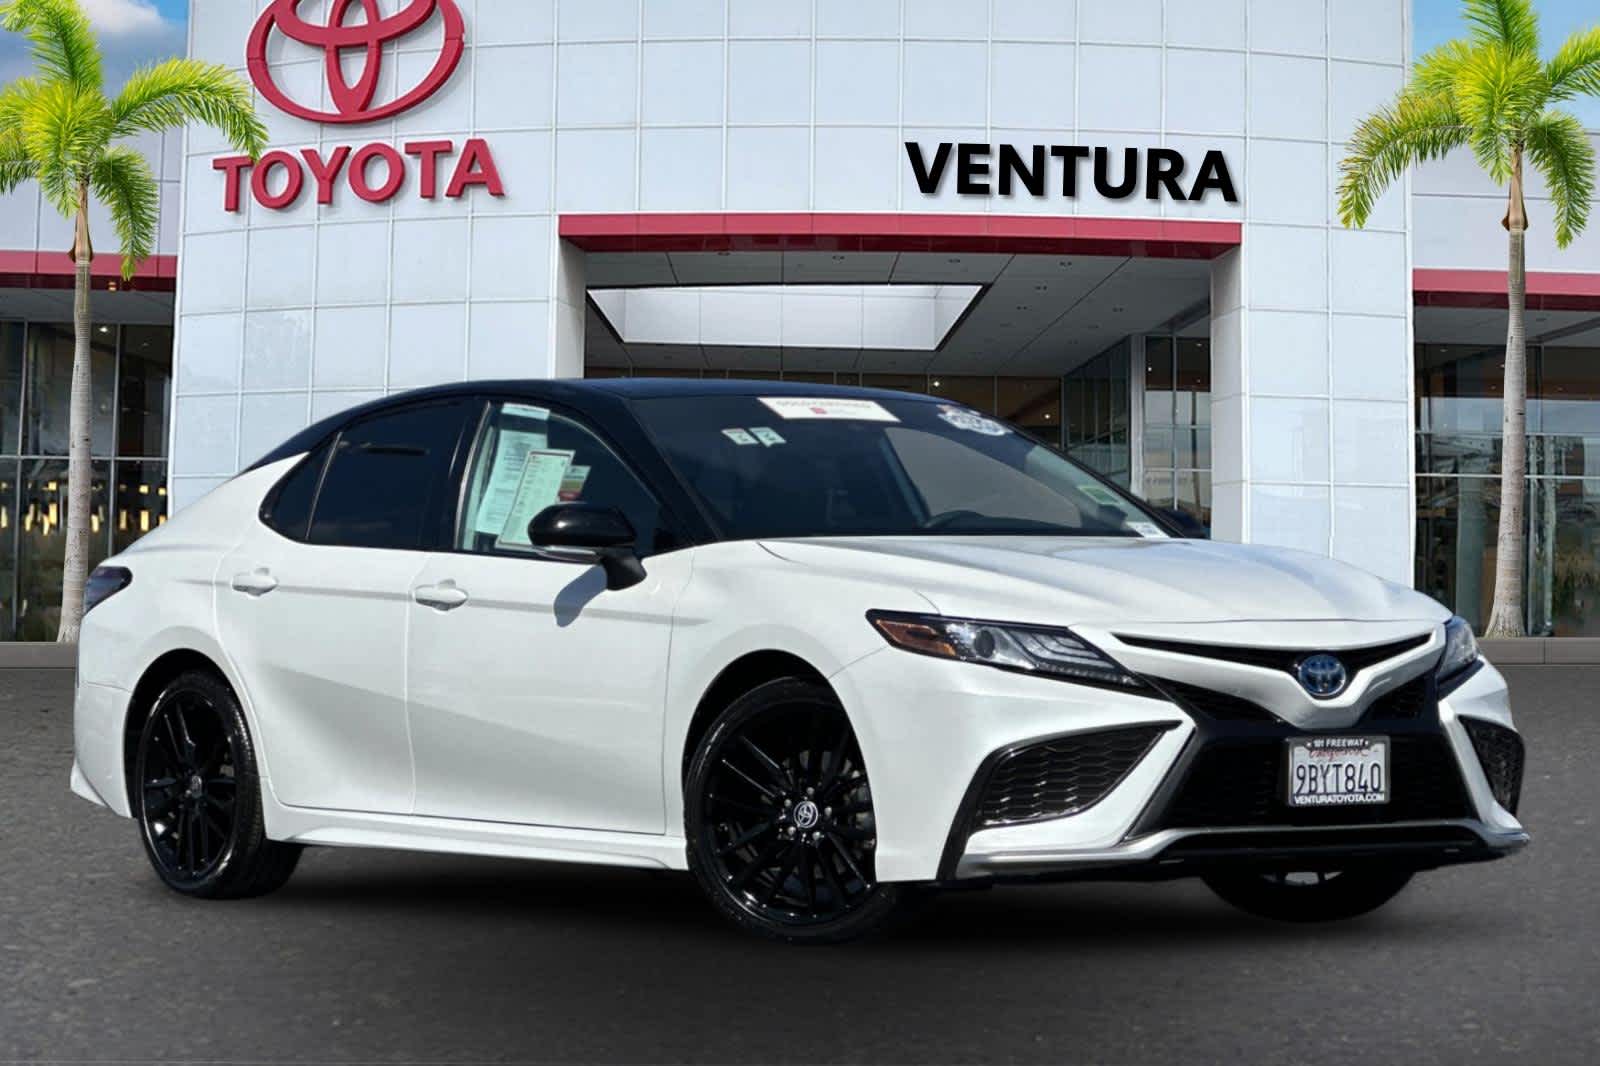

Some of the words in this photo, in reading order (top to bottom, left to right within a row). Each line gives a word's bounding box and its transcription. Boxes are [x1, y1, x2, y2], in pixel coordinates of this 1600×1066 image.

[212, 138, 505, 212] TOYOTA
[904, 141, 1239, 203] VENTURA
[1326, 738, 1364, 747] FREEWAY
[1295, 763, 1382, 795] 9BYT840
[1294, 793, 1385, 805] VENTURATOYOTA.COM
